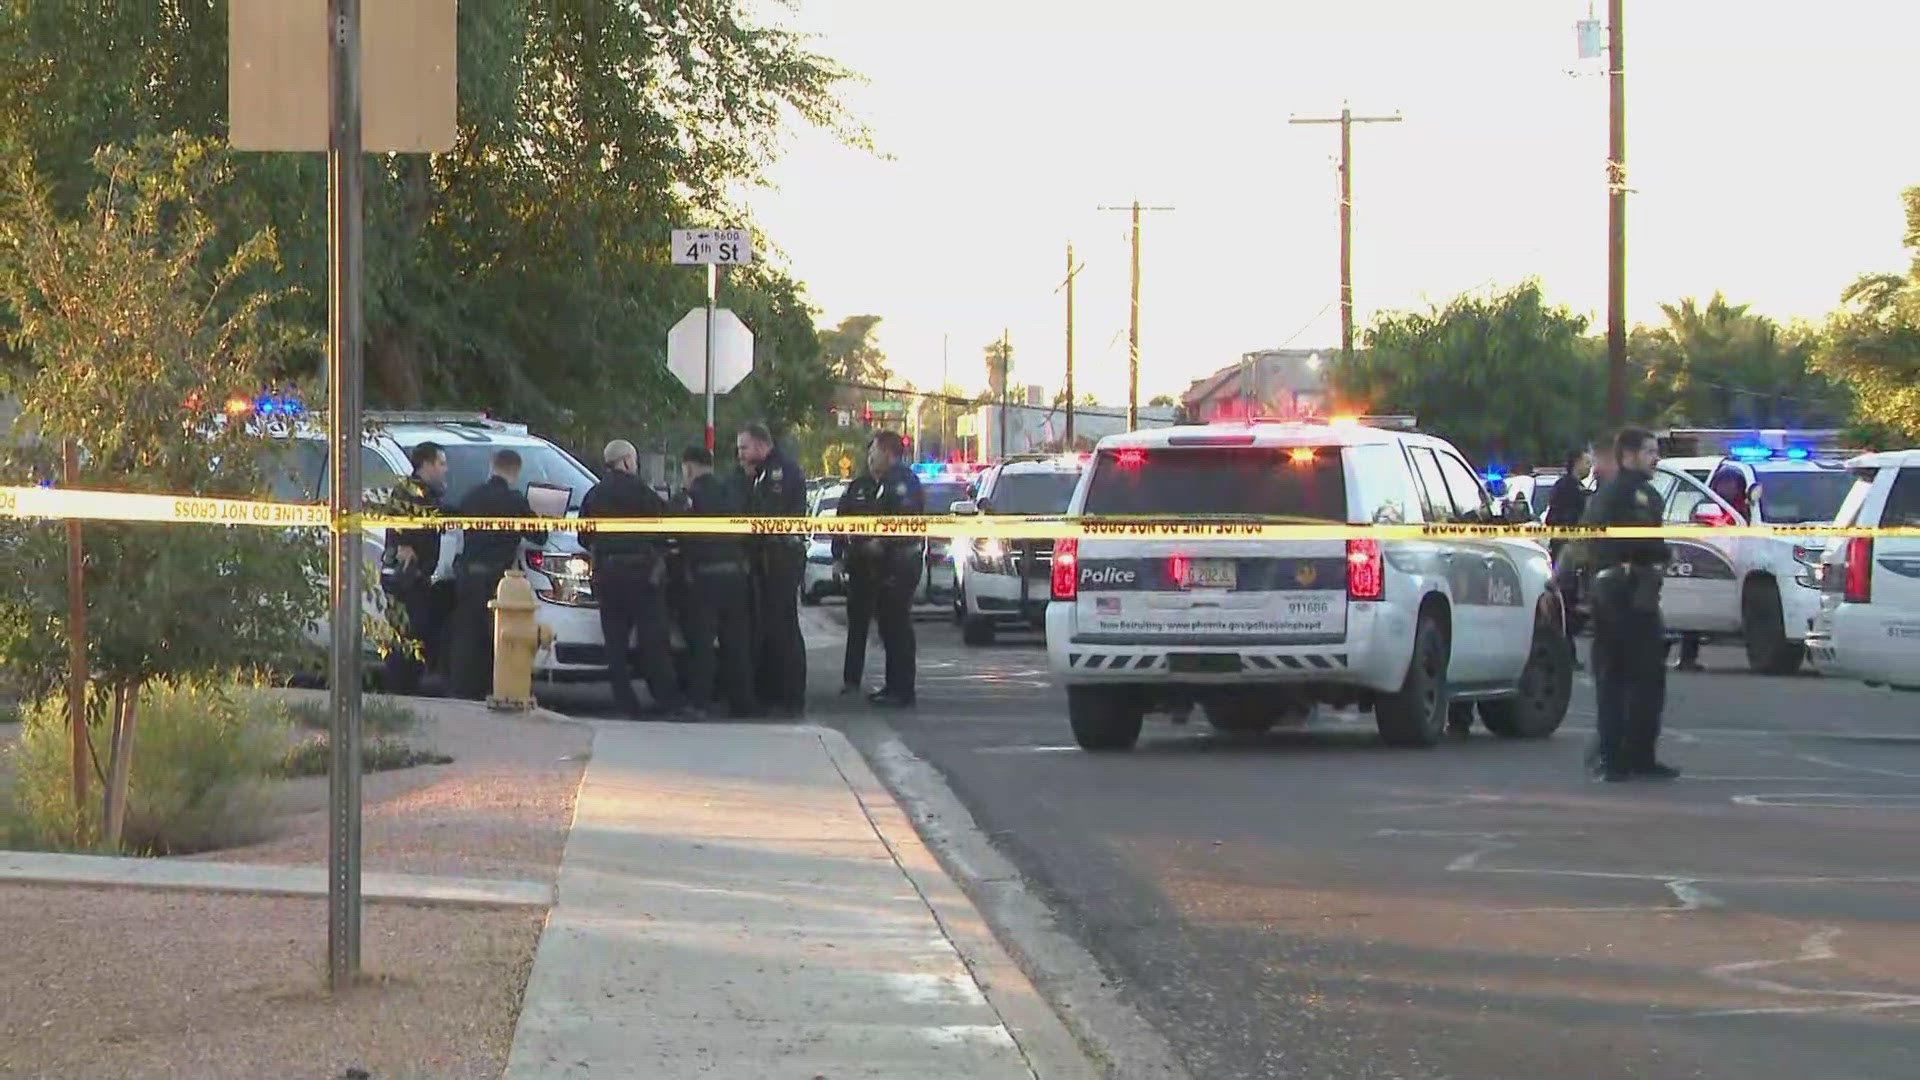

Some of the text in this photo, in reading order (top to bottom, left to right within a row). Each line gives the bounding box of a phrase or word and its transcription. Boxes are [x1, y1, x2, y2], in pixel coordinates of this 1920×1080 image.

[686, 242, 739, 261] 4th St
[174, 501, 217, 519] CROSS
[221, 503, 247, 519] NOT
[252, 505, 272, 520] DO
[274, 506, 303, 521] LINE
[1080, 567, 1135, 583] Police
